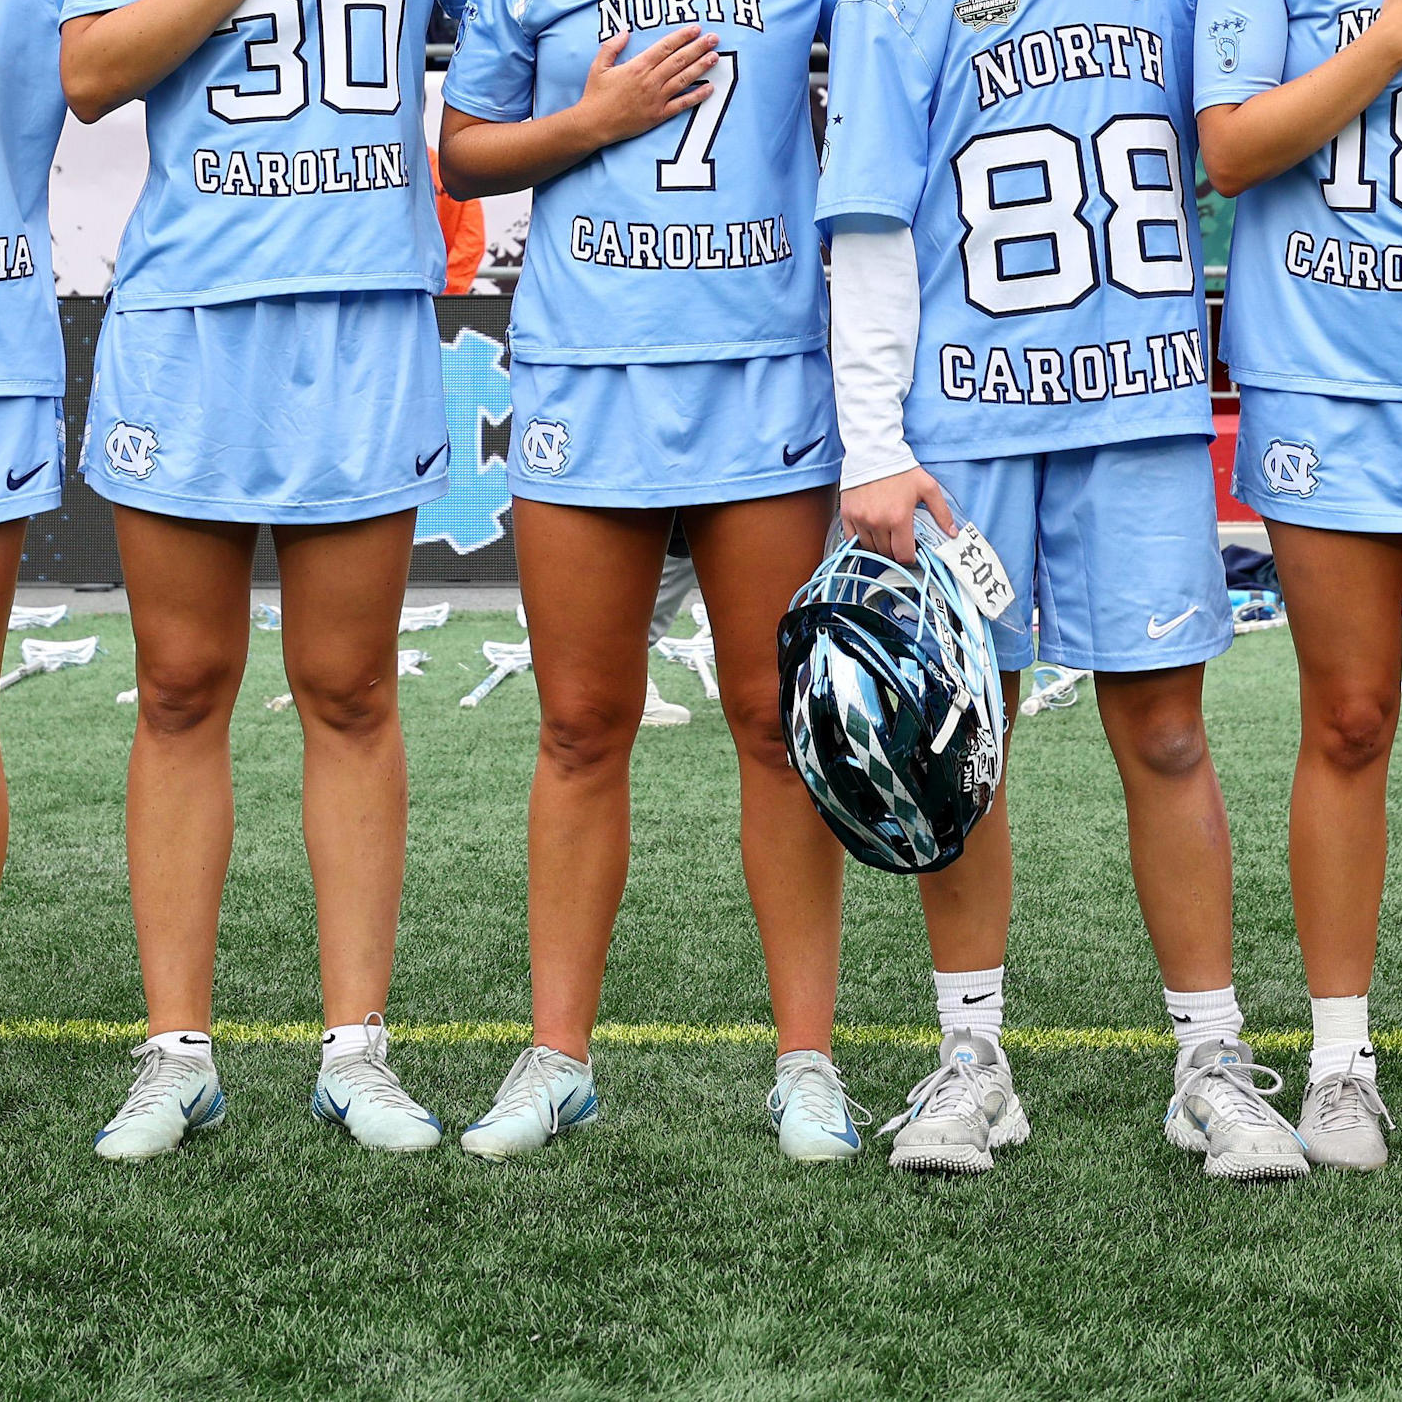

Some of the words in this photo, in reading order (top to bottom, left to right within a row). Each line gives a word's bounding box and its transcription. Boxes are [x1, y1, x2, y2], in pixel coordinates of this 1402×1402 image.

[972, 23, 1166, 111] NORTH
[656, 51, 739, 192] 7
[193, 142, 410, 197] CAROLIN
[570, 212, 793, 271] CAROLINA
[950, 113, 1195, 319] 88
[939, 327, 1206, 405] CAROLIN
[963, 764, 973, 793] UNC
